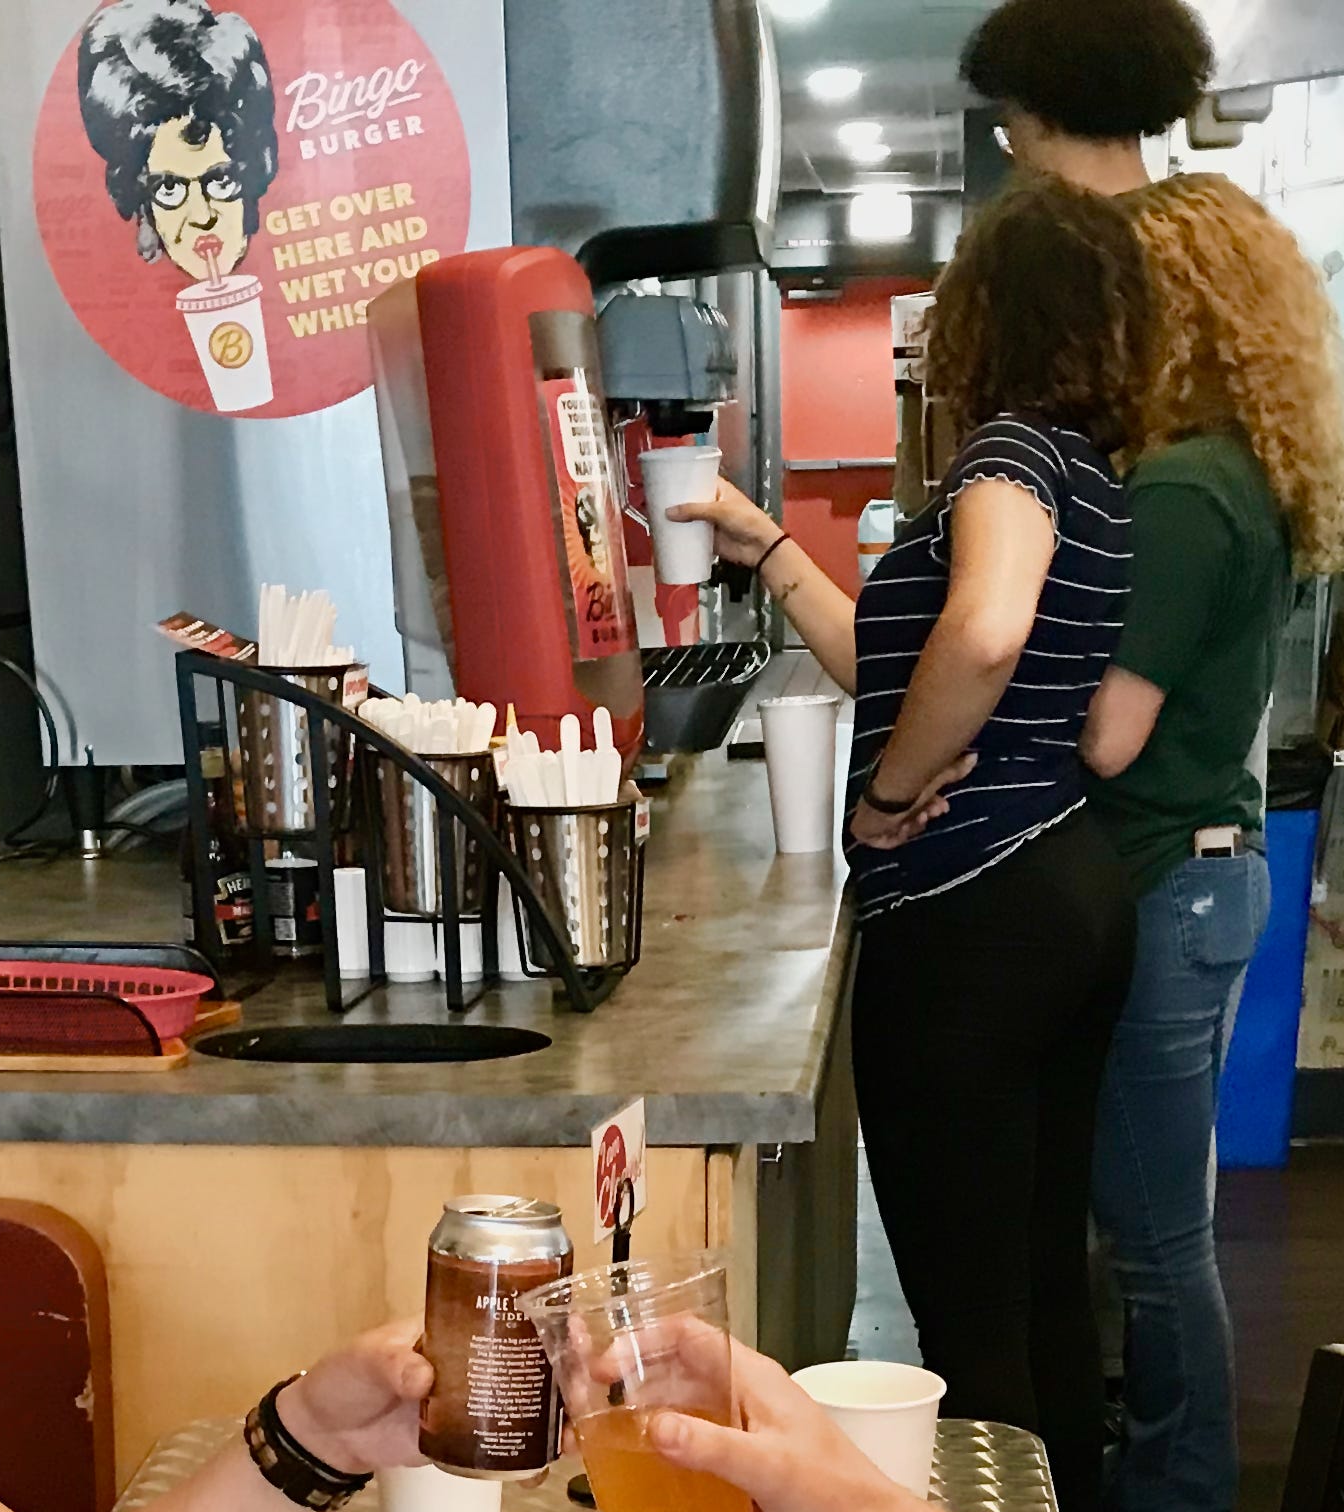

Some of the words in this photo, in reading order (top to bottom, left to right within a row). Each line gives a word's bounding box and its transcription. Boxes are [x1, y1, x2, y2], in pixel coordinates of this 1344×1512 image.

[284, 58, 426, 133] Bingo
[299, 115, 425, 160] BURGER
[265, 201, 322, 236] GET
[329, 182, 416, 222] OVER
[272, 231, 354, 271] HERE
[360, 216, 428, 252] AND
[279, 267, 347, 304] WET
[286, 296, 376, 338] WHIS
[217, 331, 243, 363] B
[476, 1295, 509, 1311] APPLE
